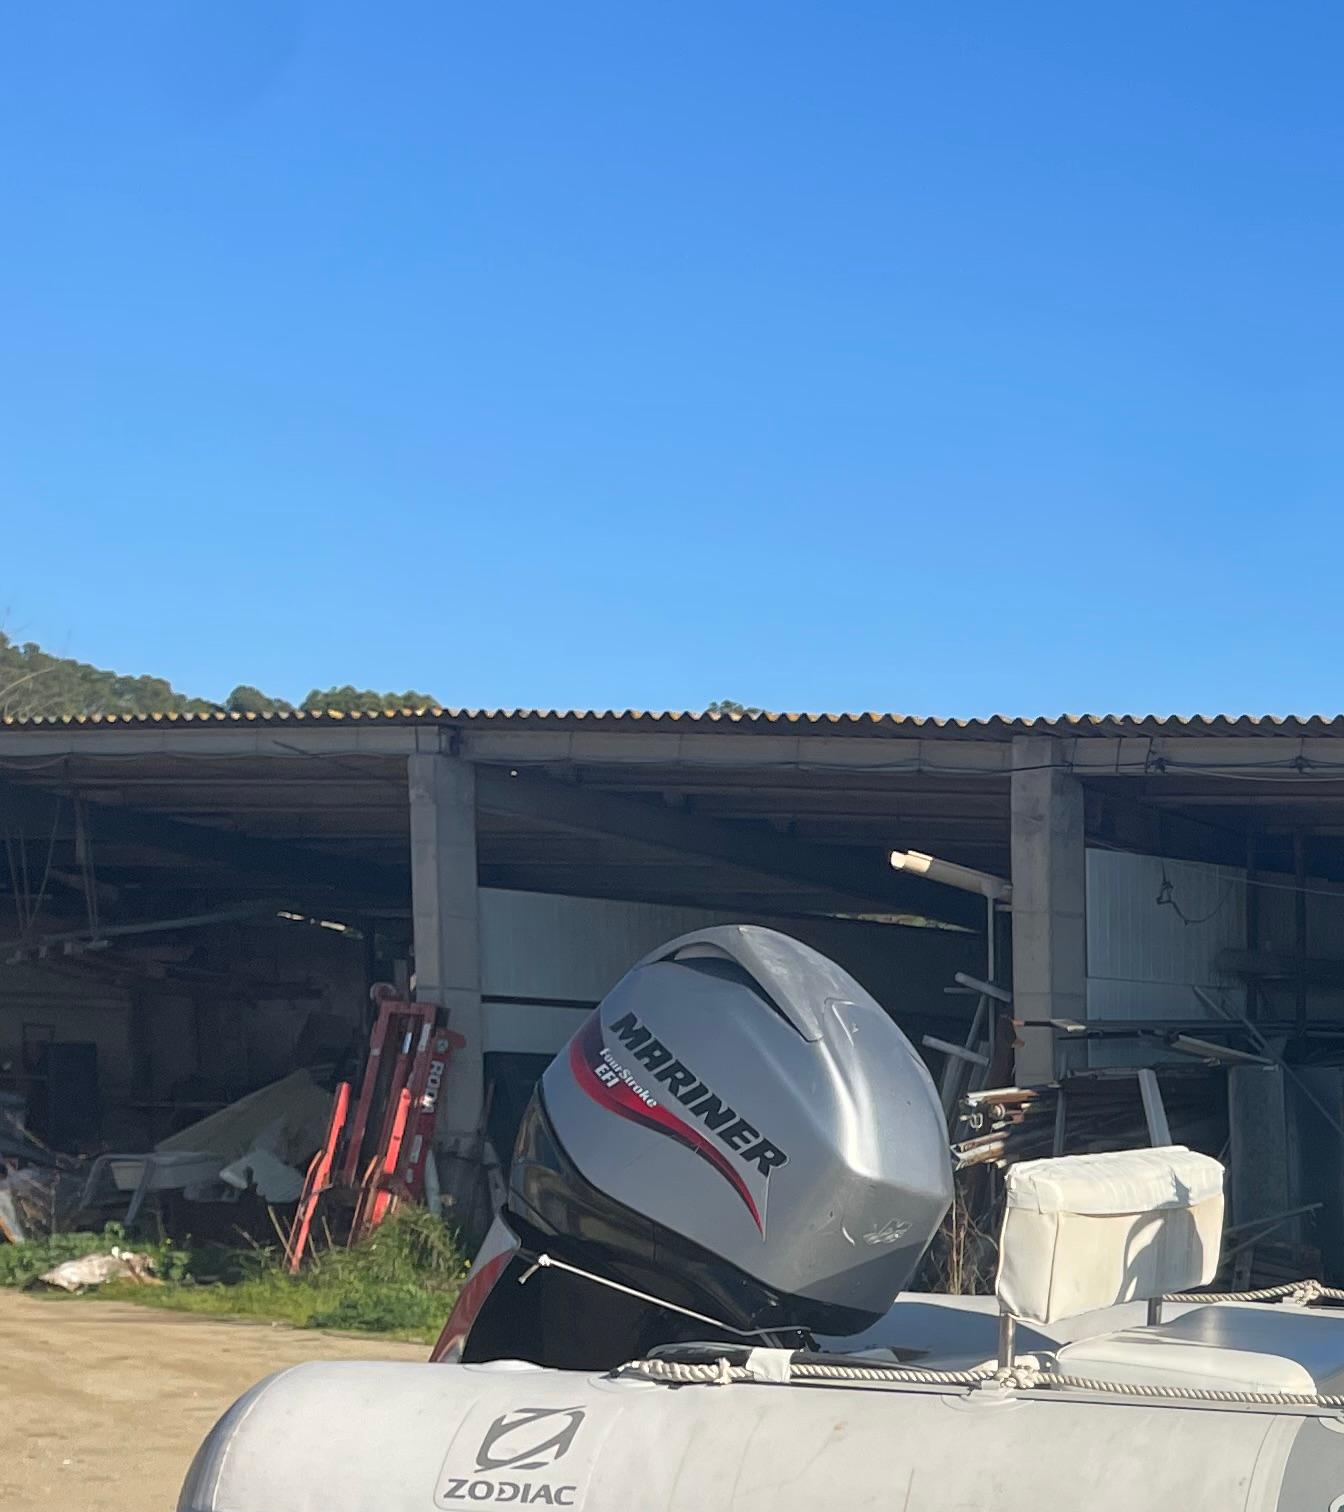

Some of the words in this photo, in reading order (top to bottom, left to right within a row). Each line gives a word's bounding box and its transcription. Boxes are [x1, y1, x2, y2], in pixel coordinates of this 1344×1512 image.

[594, 1063, 620, 1088] EFI
[599, 1047, 657, 1108] FourStroke
[609, 1011, 788, 1178] MARINER
[443, 1478, 577, 1506] ZODIAC
